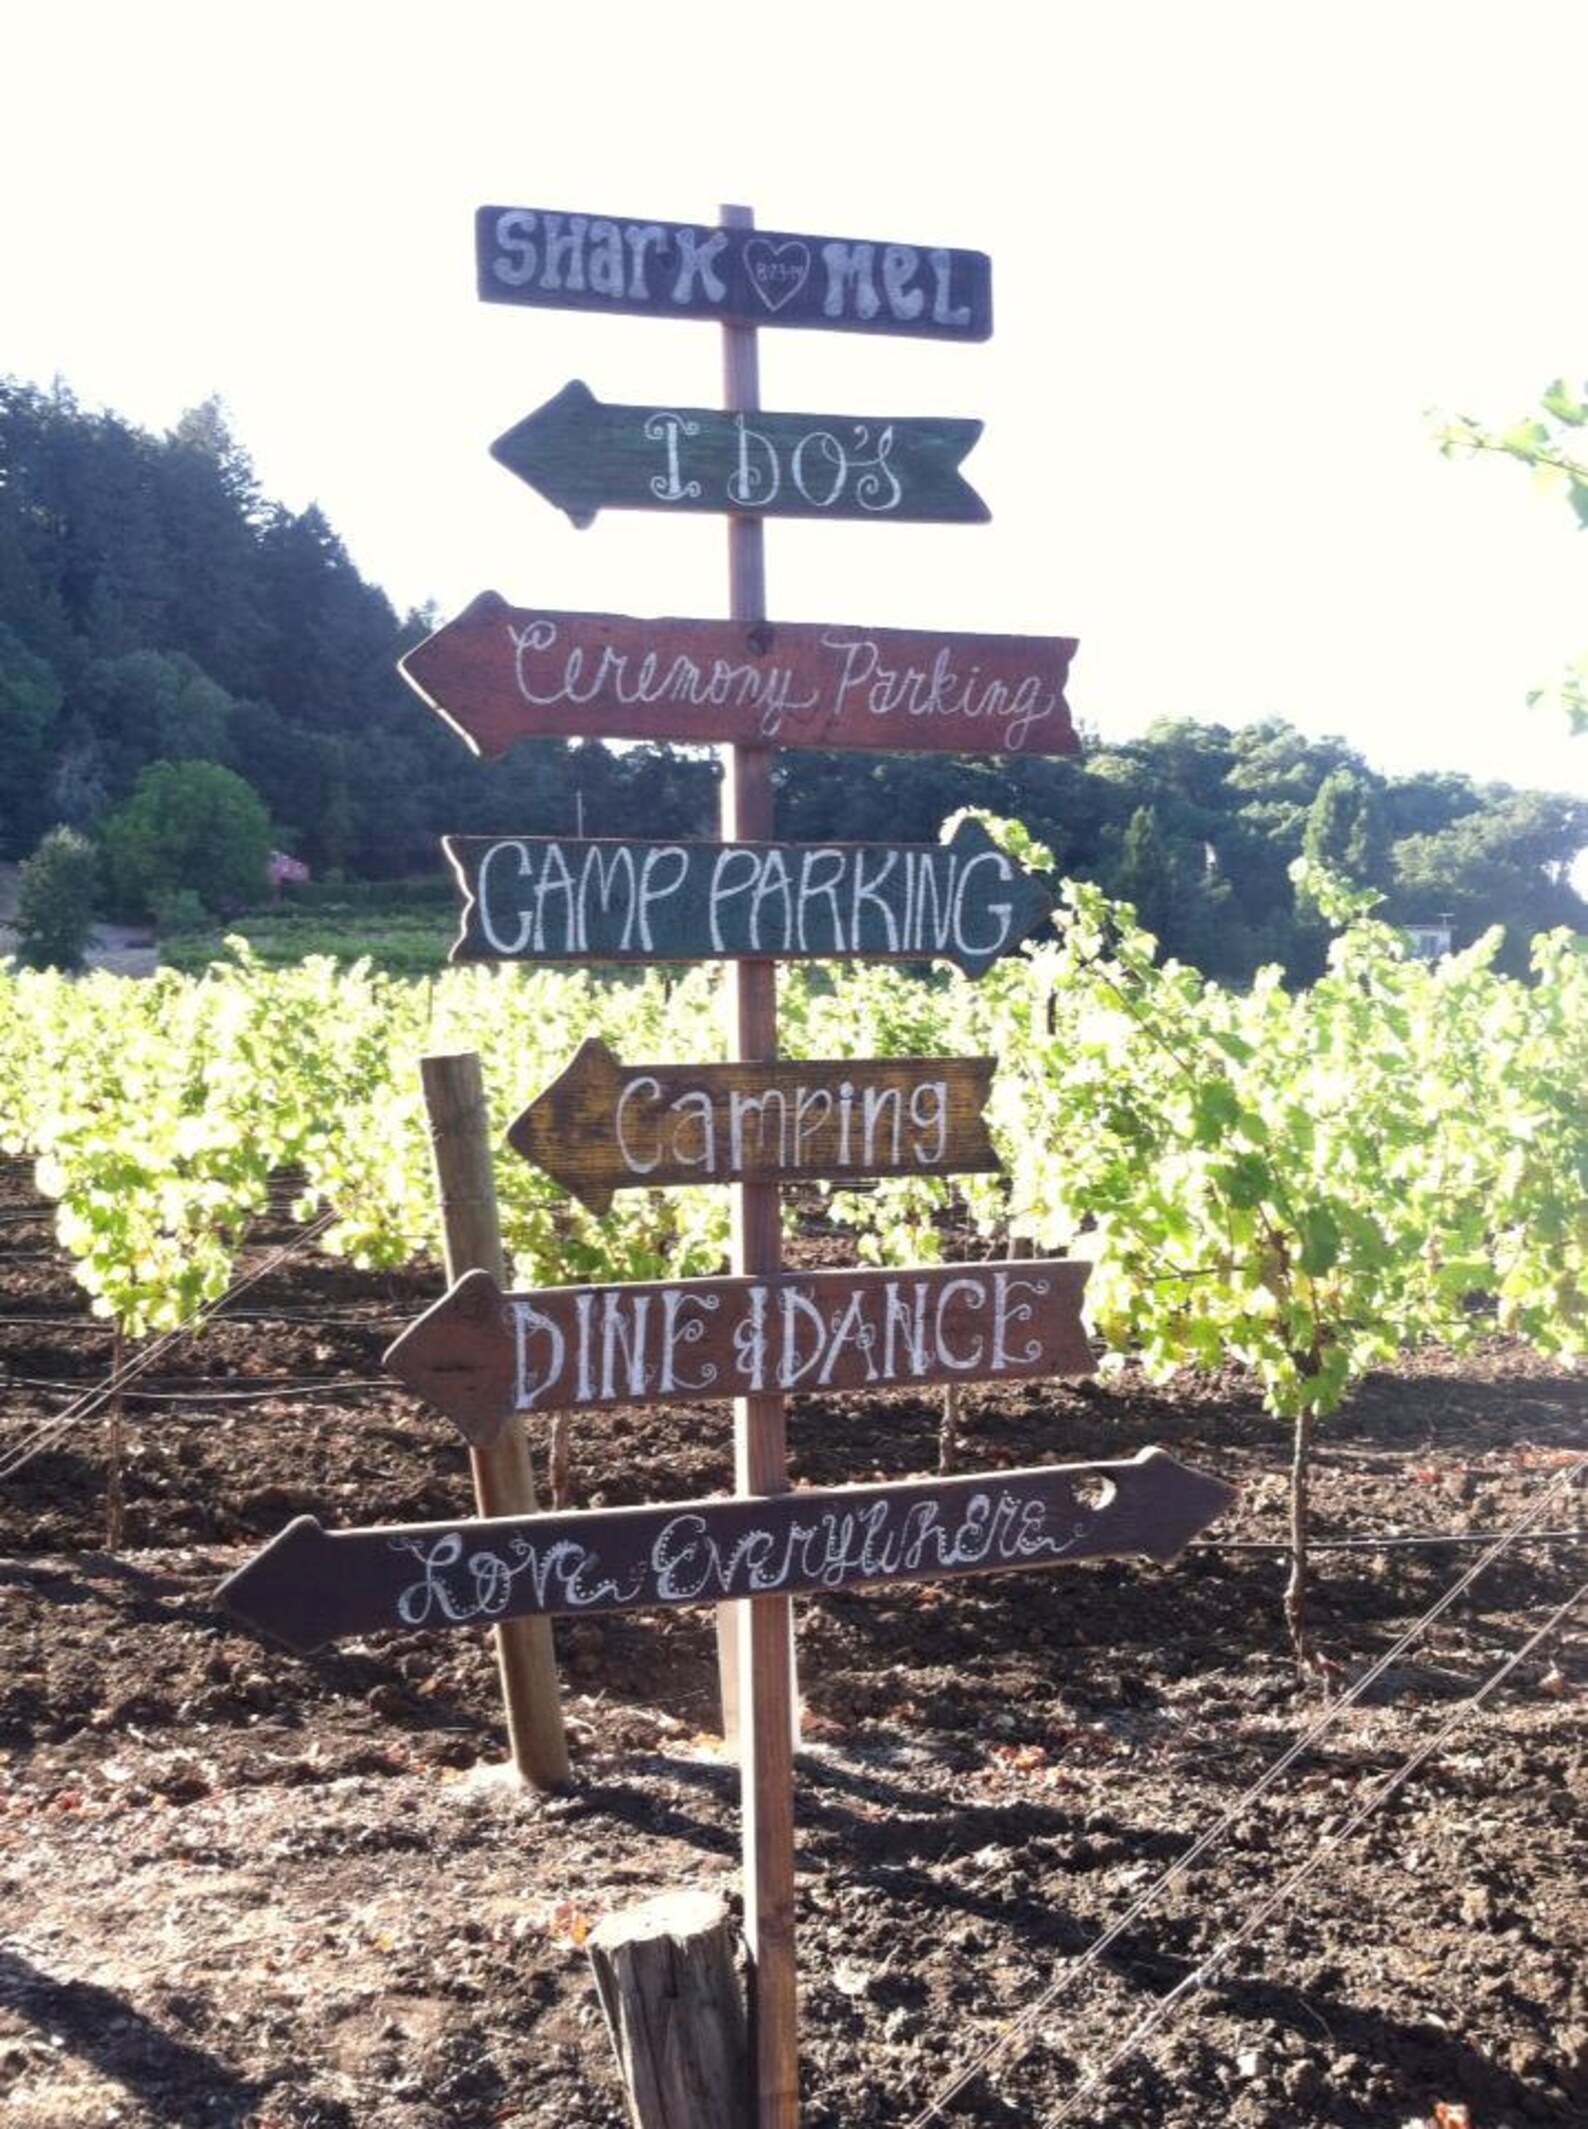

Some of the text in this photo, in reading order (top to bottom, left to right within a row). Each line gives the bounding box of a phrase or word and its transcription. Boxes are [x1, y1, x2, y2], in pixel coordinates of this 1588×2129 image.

[645, 412, 700, 500] I
[508, 620, 1056, 752] Ceremony Parking
[478, 840, 1013, 956] CAMP PARKING
[616, 1076, 950, 1175] Camping
[502, 1288, 719, 1409] DINE
[774, 1271, 1051, 1389] DANCE
